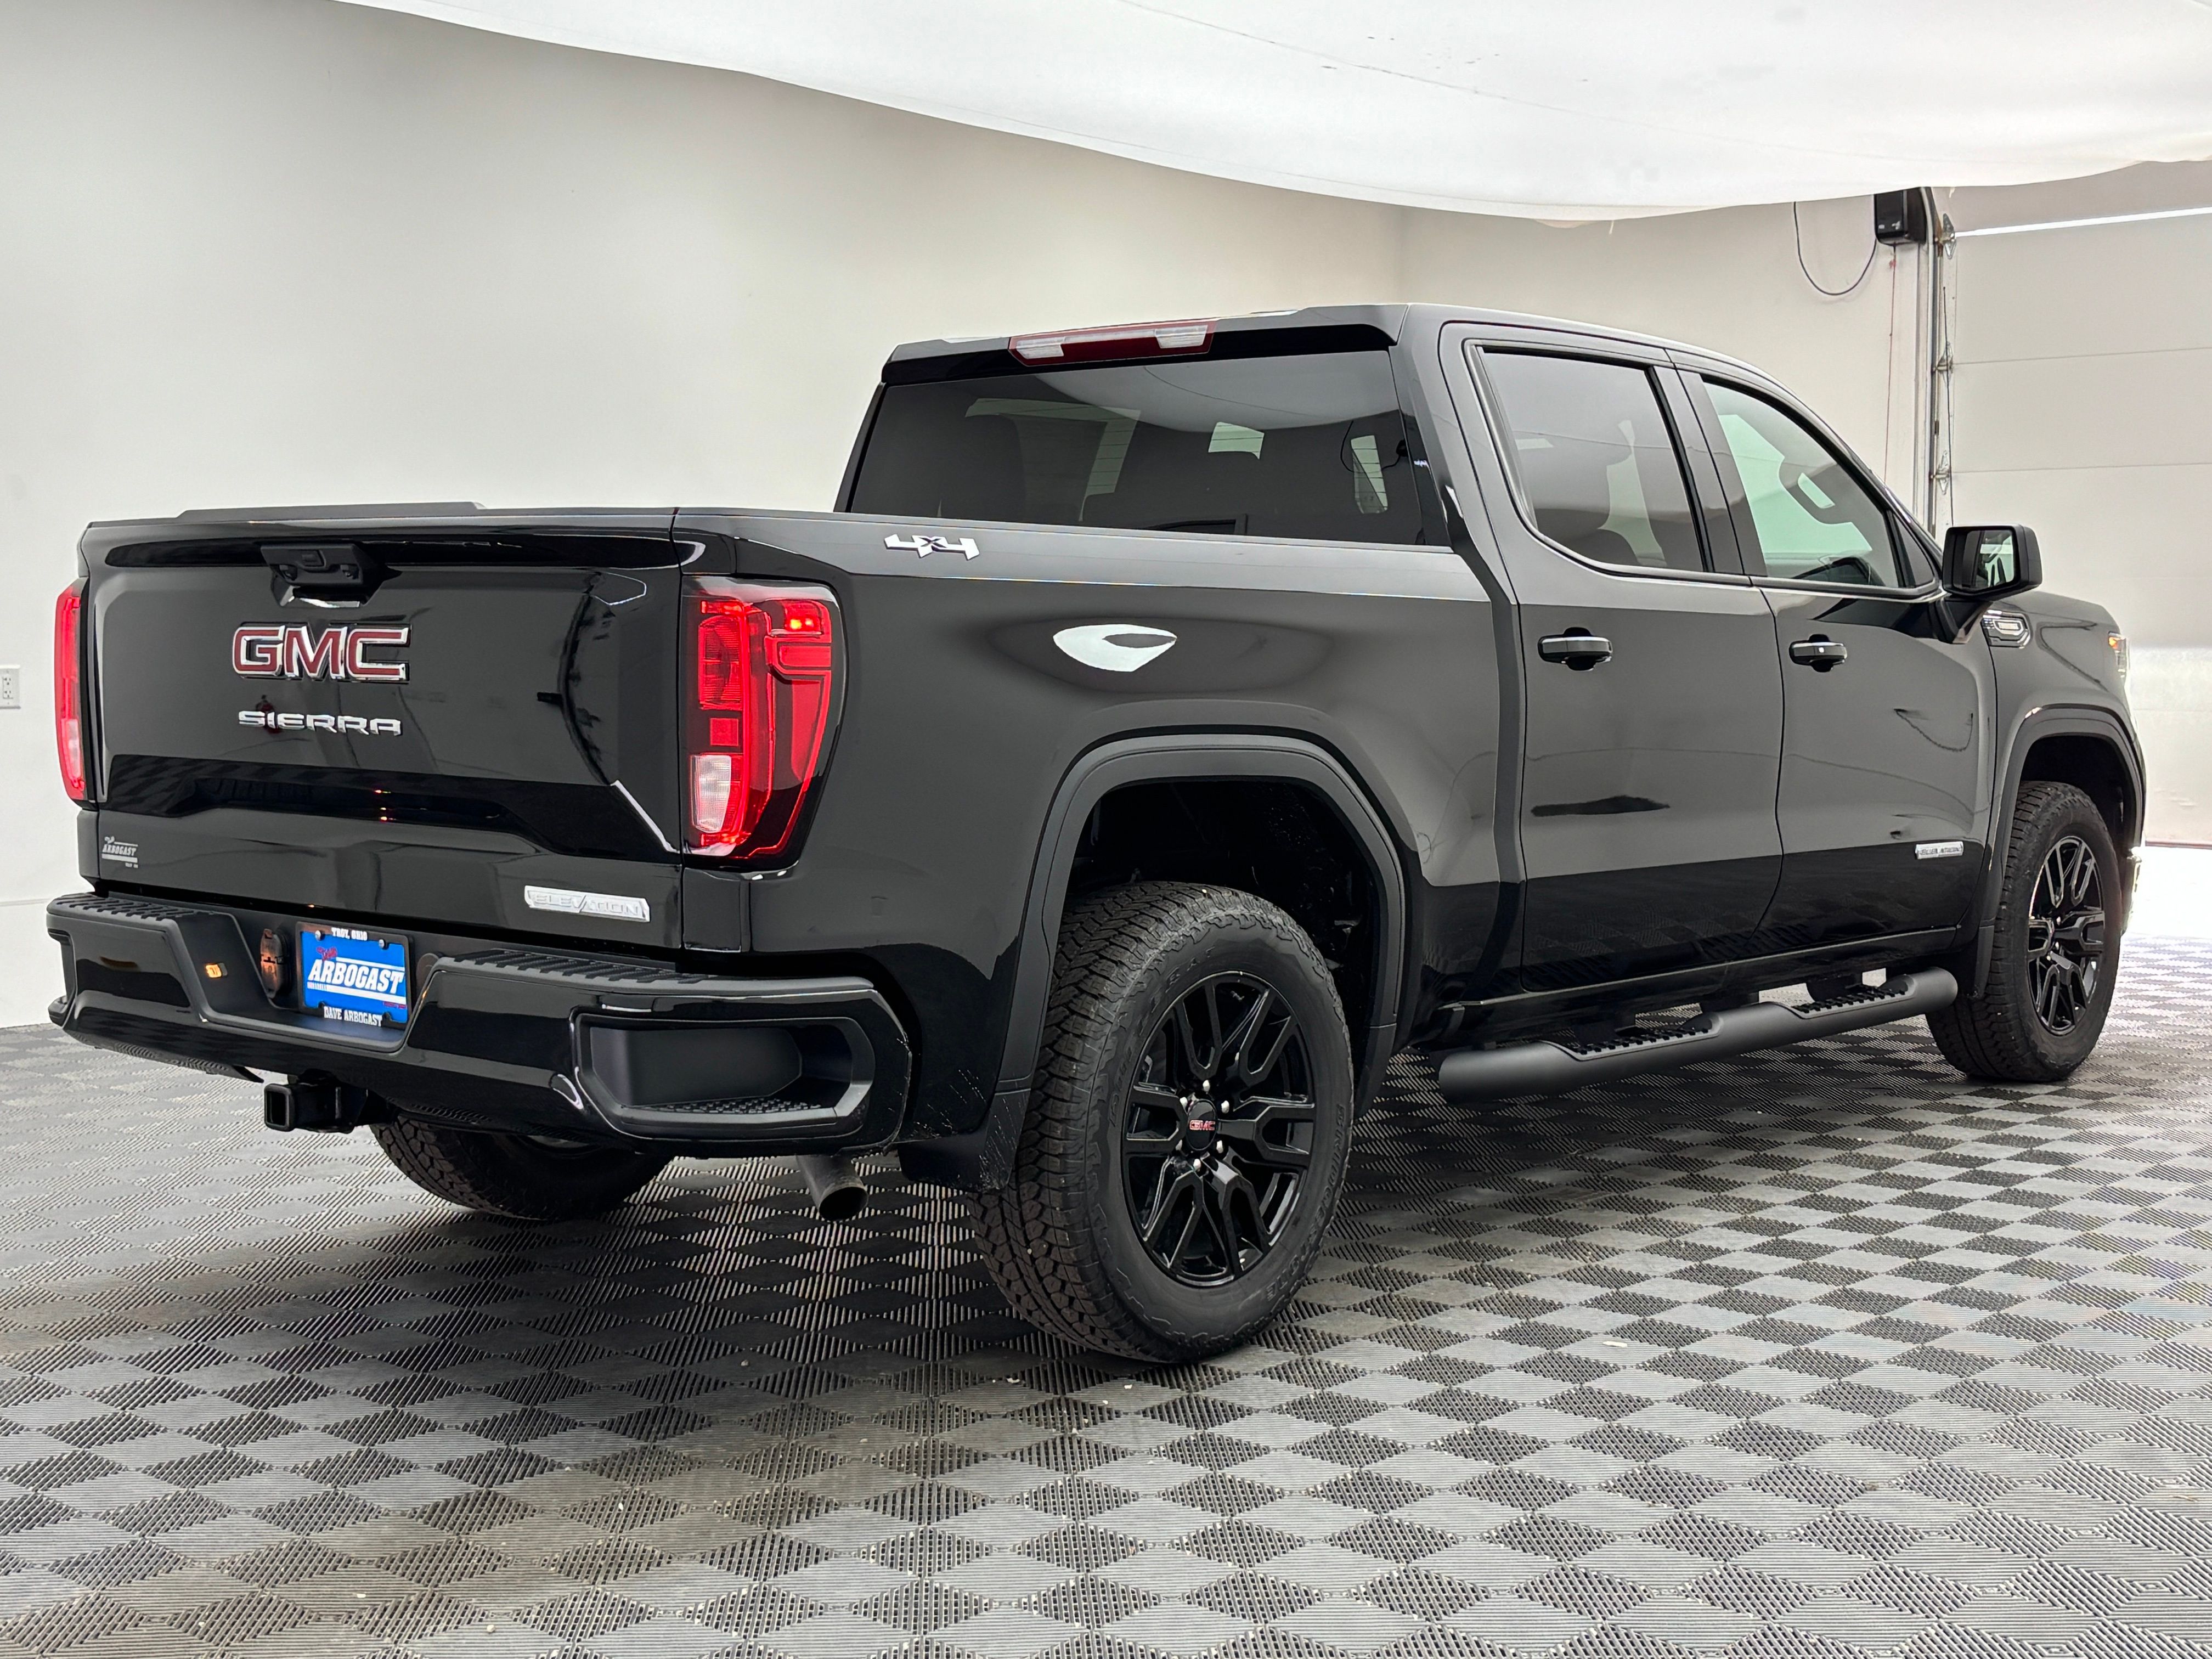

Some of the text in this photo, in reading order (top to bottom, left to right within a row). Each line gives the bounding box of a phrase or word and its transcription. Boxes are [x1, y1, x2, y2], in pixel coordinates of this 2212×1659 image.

[233, 625, 410, 682] GMC
[239, 710, 401, 736] SIERRA
[532, 893, 642, 917] ELEVATION
[308, 959, 404, 994] ARBOGAST
[324, 1007, 383, 1026] DAVE ARBOGAST
[1189, 1120, 1216, 1131] GMC
